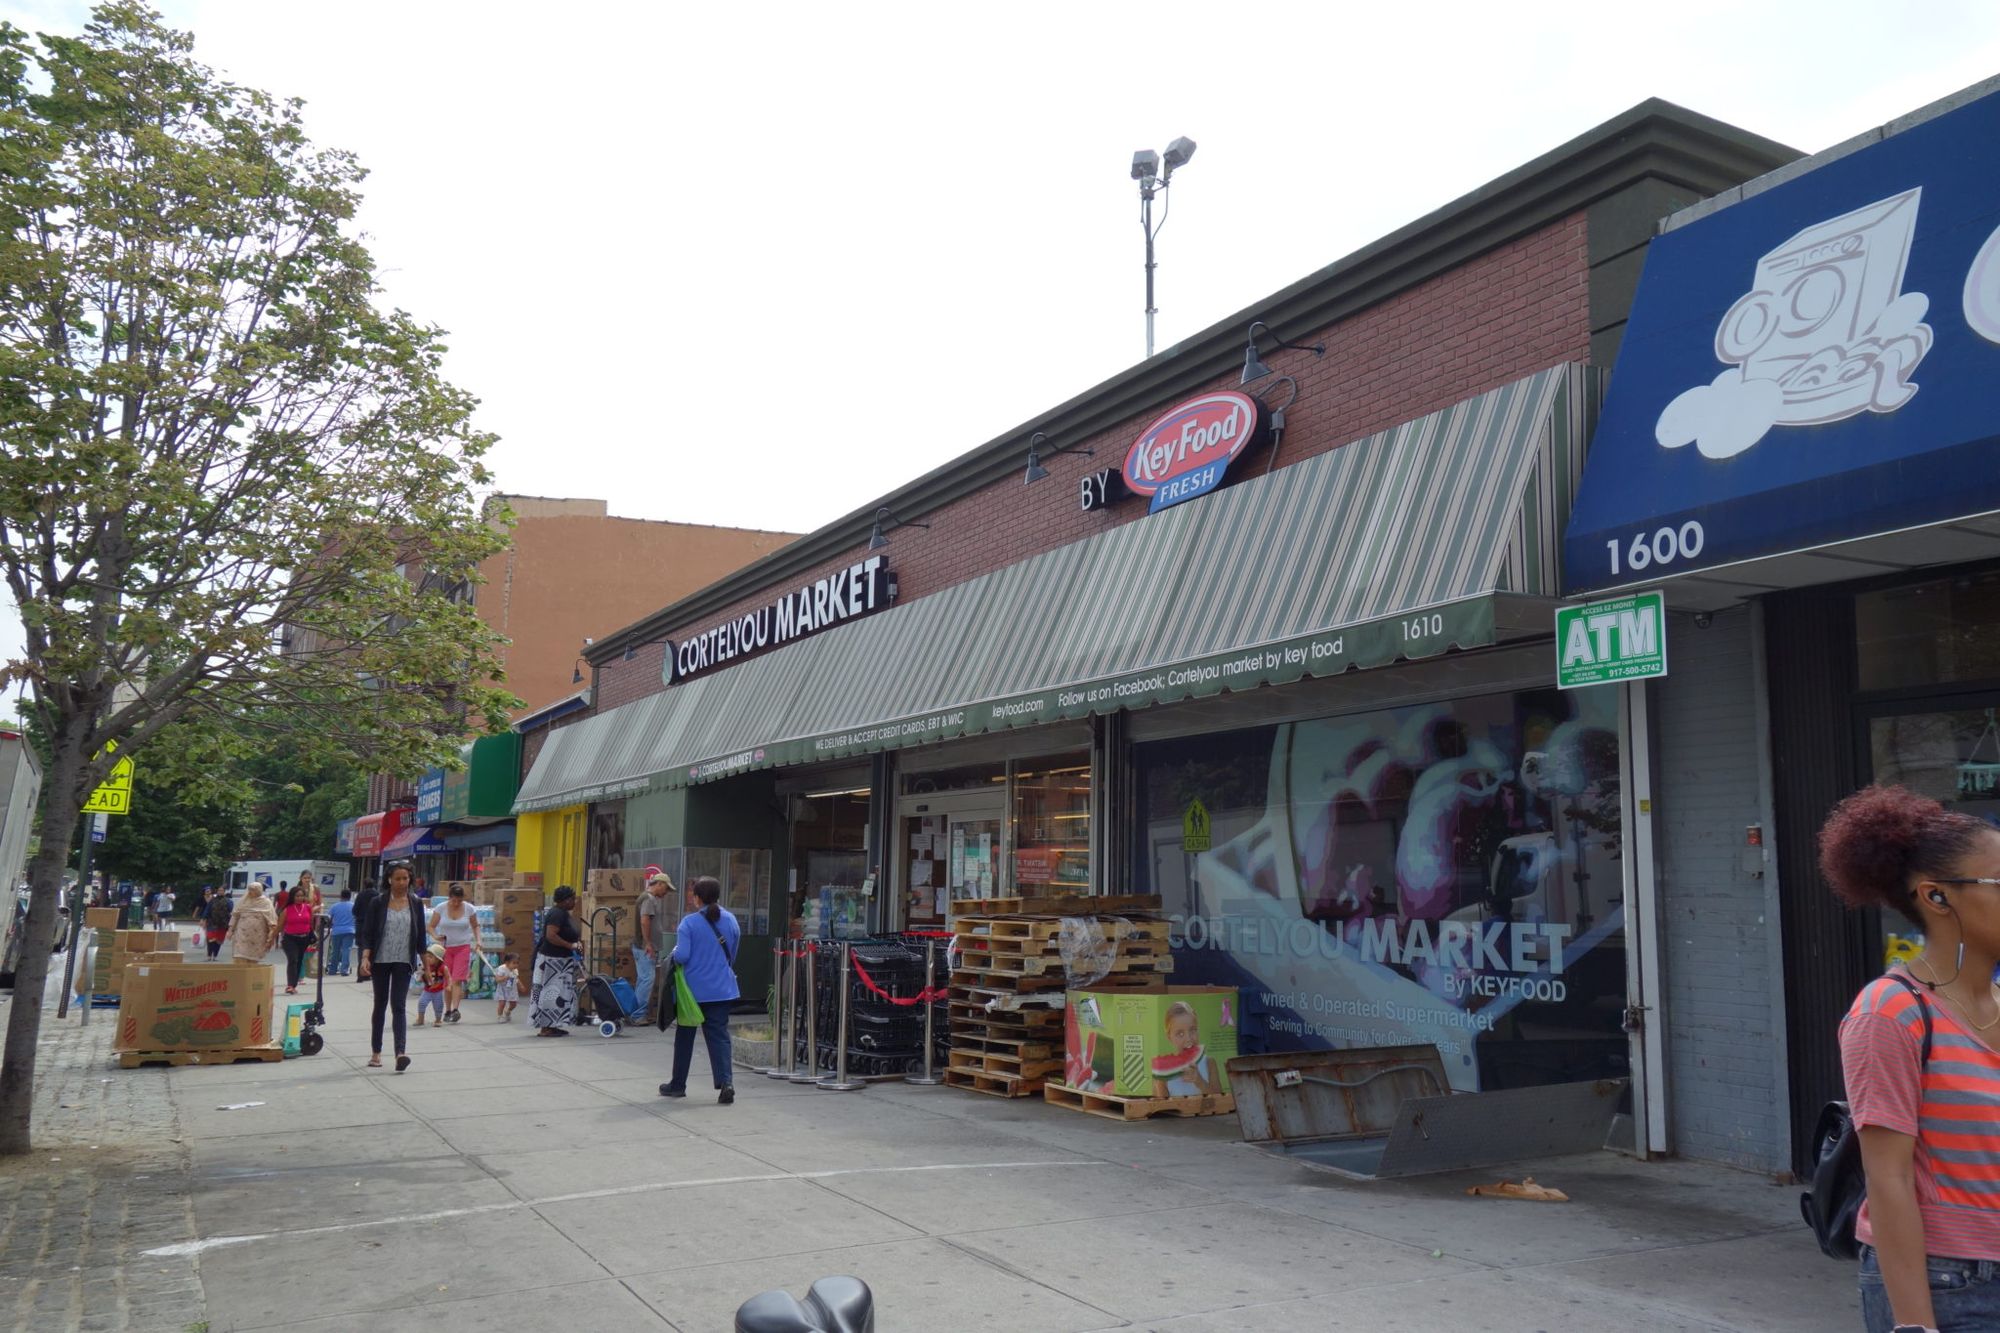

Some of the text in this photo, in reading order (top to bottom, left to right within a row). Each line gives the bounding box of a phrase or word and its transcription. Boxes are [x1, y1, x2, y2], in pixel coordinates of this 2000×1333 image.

[1081, 467, 1110, 511] BY
[1159, 467, 1215, 503] FRESH
[1606, 520, 1704, 575] 1600
[677, 554, 881, 677] CORTELYOU MARKET
[1612, 600, 1636, 610] MONEY
[1401, 613, 1443, 642] 1610
[1562, 605, 1657, 667] ATM
[1057, 690, 1084, 708] Follow
[1087, 689, 1097, 701] us
[1100, 687, 1111, 700] on
[1168, 664, 1220, 688] Cortelyou
[1223, 652, 1264, 677] market
[1266, 648, 1282, 671] by
[1284, 643, 1308, 666] key
[1310, 635, 1343, 660] food
[1608, 663, 1661, 678] 917-500-5742
[992, 698, 1044, 720] keyfood.com
[825, 734, 847, 750] DELIVER
[853, 731, 878, 745] ACCEPT
[878, 726, 901, 740] CREDIT
[901, 719, 927, 736] CARDS,
[928, 716, 941, 731] EBT
[941, 715, 948, 727] &
[948, 711, 965, 725] WIC
[88, 791, 121, 807] EAD
[1167, 914, 1572, 975] CORTELYOU MARKET
[165, 979, 228, 1002] WATERMELONS
[1443, 974, 1567, 1002] By KEYFOOD
[1260, 991, 1495, 1032] wned & Operated Supermarket
[1304, 1021, 1314, 1035] to
[1315, 1023, 1369, 1046] Community
[1371, 1028, 1385, 1044] for
[1387, 1030, 1412, 1046] Over
